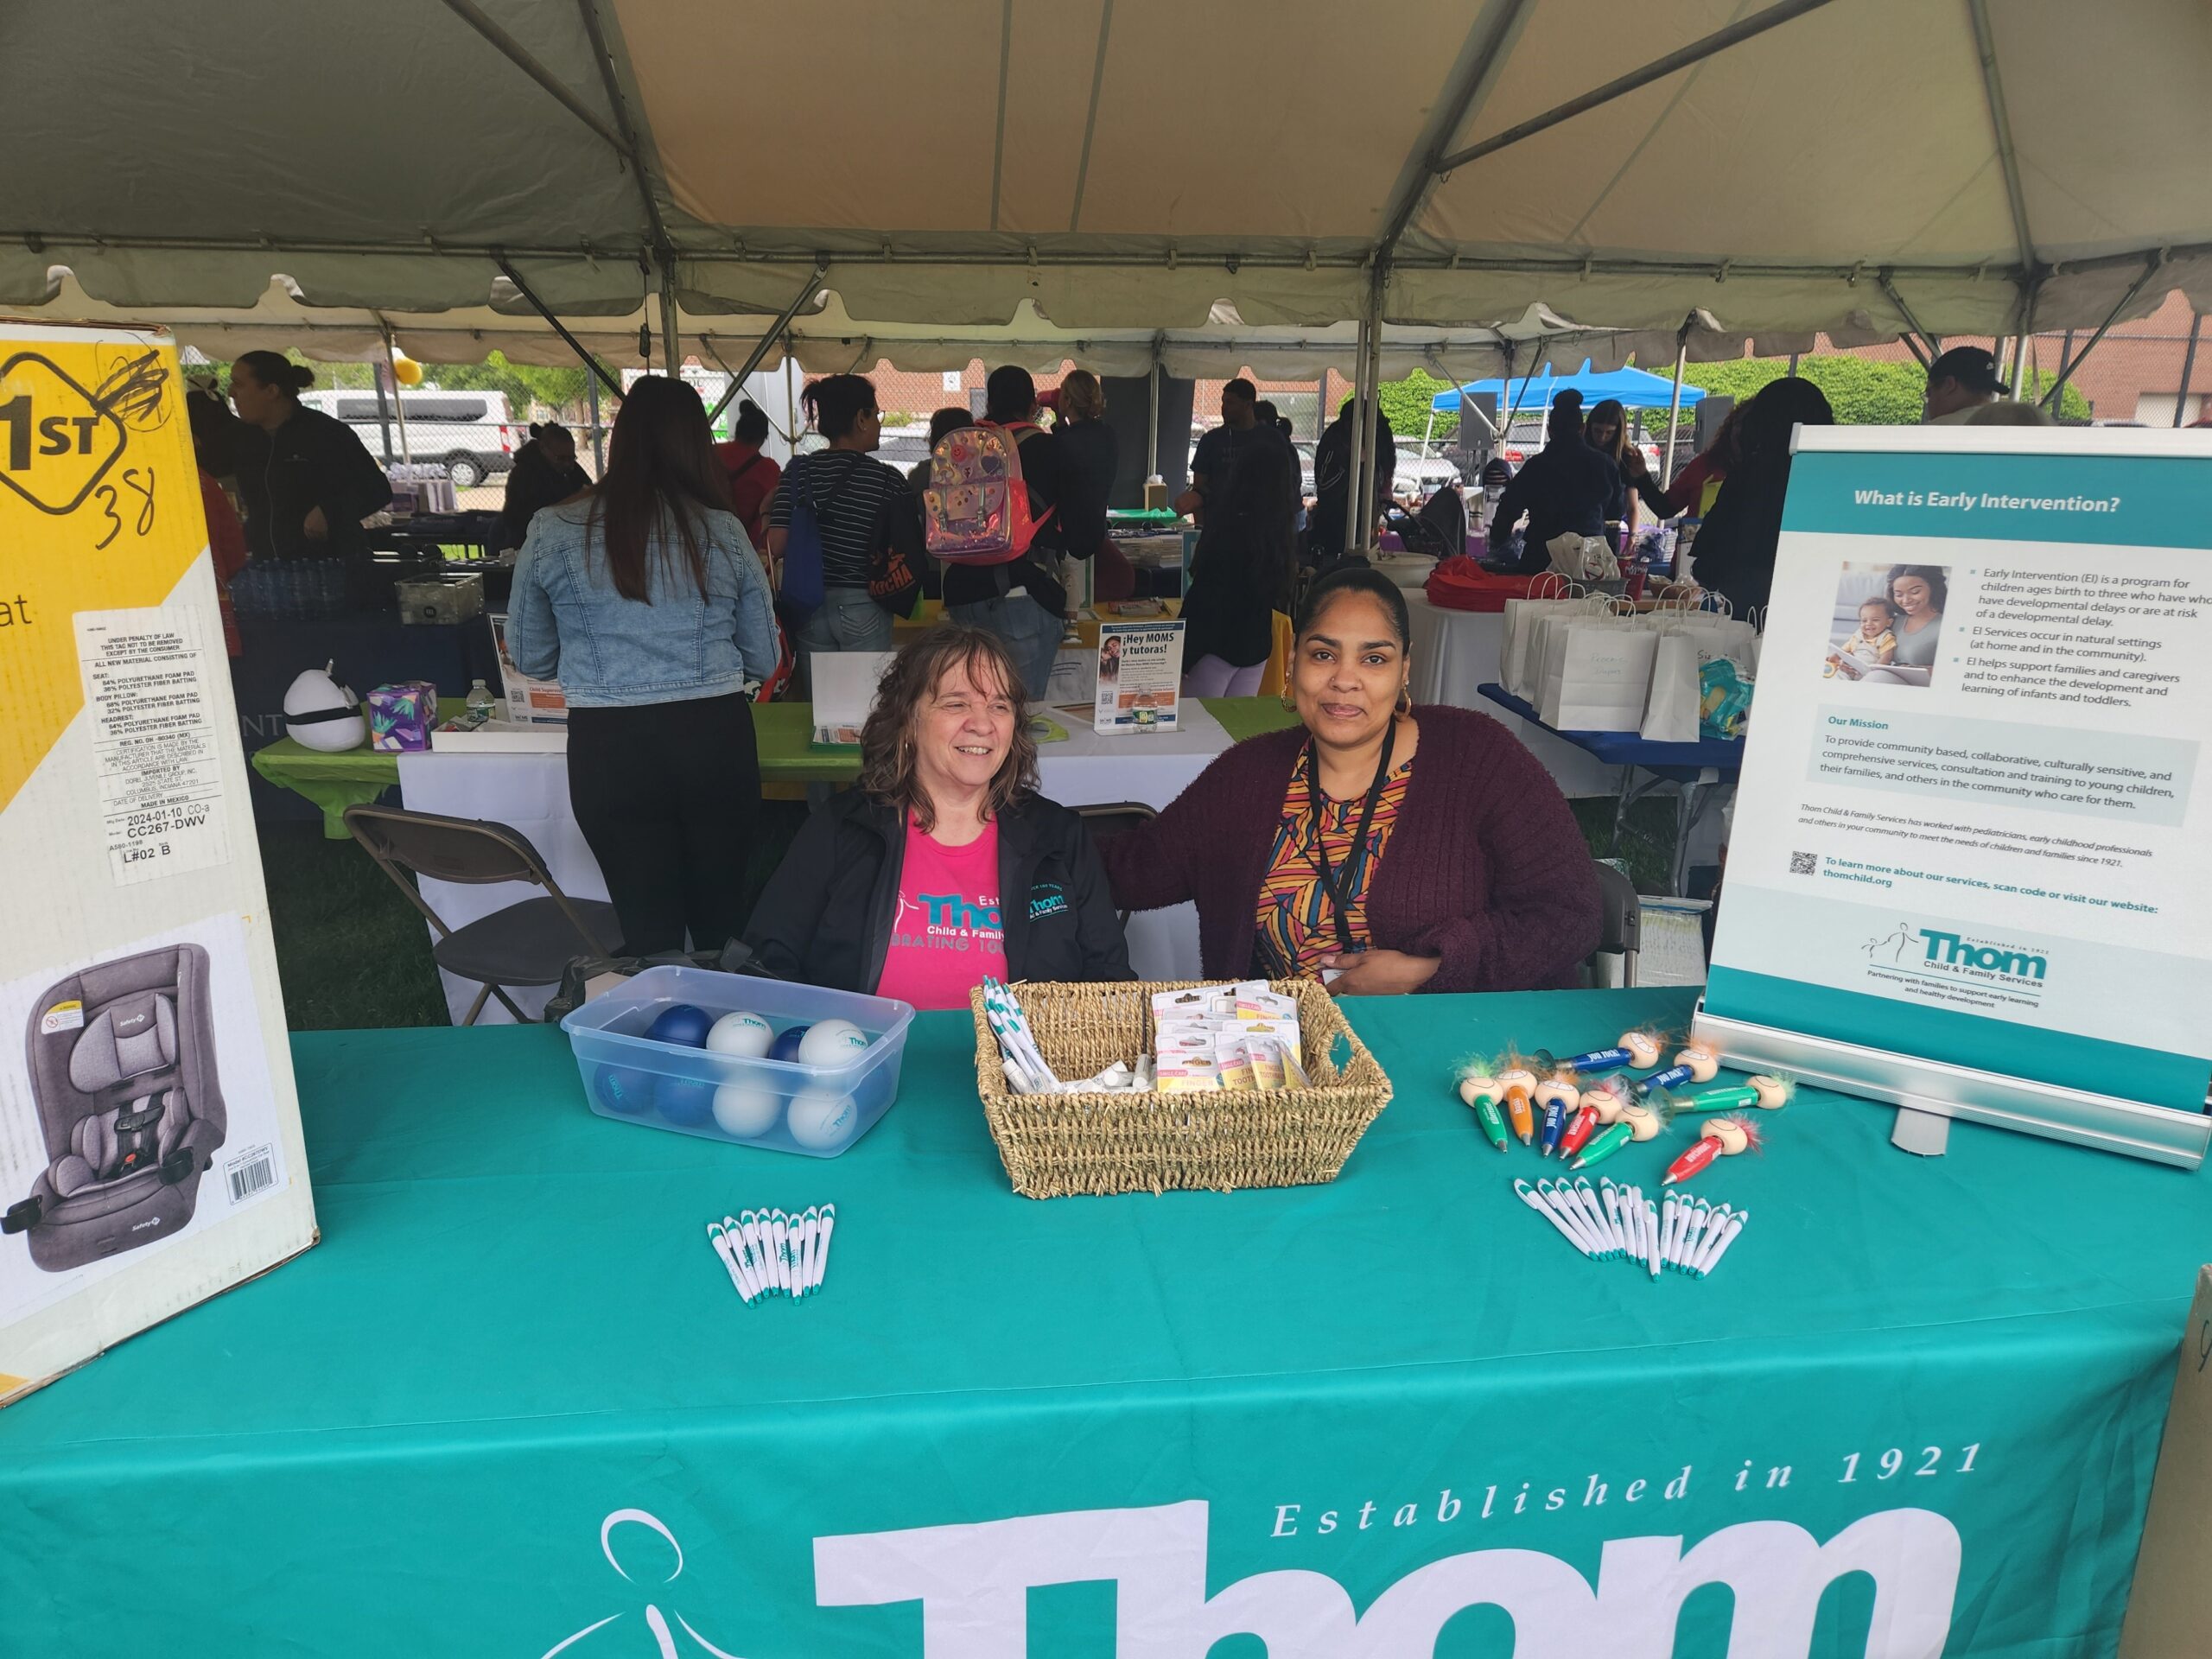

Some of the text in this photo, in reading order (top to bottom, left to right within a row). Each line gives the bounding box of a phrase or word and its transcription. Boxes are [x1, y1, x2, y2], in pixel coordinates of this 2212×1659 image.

[94, 466, 156, 550] 38
[1854, 489, 2120, 512] What is Early Intervention?
[1983, 568, 2010, 580] Early
[2011, 570, 2079, 582] Intervention
[2080, 573, 2098, 584] (EI)
[2100, 574, 2110, 584] is
[2120, 577, 2171, 588] program
[2173, 578, 2190, 588] for
[1980, 581, 2024, 592] children
[2026, 586, 2052, 596] ages
[2054, 585, 2081, 596] birth
[2083, 588, 2096, 597] to
[2098, 588, 2128, 599] three
[2130, 590, 2155, 601] who
[2157, 591, 2186, 603] have
[1975, 608, 1989, 618] of
[1997, 610, 2080, 624] developmental
[2081, 615, 2113, 628] delay.
[1978, 595, 2004, 605] have
[2005, 596, 2088, 611] developmental
[2089, 602, 2126, 615] delays
[2162, 608, 2175, 617] at
[2177, 608, 2198, 618] risk
[1123, 632, 1174, 645] ¡Hey MOMS
[1972, 626, 2162, 650] EI Services occur in natural settings
[122, 656, 152, 664] MATERIAL
[153, 652, 188, 662] CONSISTING
[1122, 644, 1167, 657] y tutoras!
[1970, 639, 2146, 663] (at home and in the community).
[1966, 656, 2180, 683] EI helps support families and caregivers
[1961, 683, 2131, 707] learning of infants and toddlers.
[1963, 671, 2168, 696] and to enhance the development and
[1827, 716, 1889, 730] Our Mission
[1824, 734, 2172, 781] To provide community based, collaborative, culturally sensitive, and
[140, 800, 158, 808] MADE
[166, 794, 189, 804] MEXICO
[127, 814, 205, 838] CC267-DWV
[161, 844, 171, 855] B
[1823, 869, 1892, 888] thomchild.org
[1825, 856, 1837, 865] To
[1838, 858, 1863, 869] learn
[1865, 864, 1892, 873] more
[1893, 867, 1924, 878] about
[1925, 873, 1944, 881] our
[1945, 876, 1990, 889] services,
[1992, 883, 2018, 892] scan
[2019, 887, 2047, 897] code
[2062, 893, 2087, 903] visit
[2088, 898, 2108, 906] our
[2110, 901, 2158, 913] website:
[927, 925, 957, 936] Child
[960, 928, 969, 937] &
[1916, 928, 2047, 980] Thom
[1923, 960, 1949, 971] Child
[1962, 967, 1996, 980] Family
[1998, 973, 2043, 988] Services
[742, 1018, 766, 1030] Thom
[1270, 1441, 1982, 1539] Established in 1921
[812, 1499, 1962, 1659] Thom
